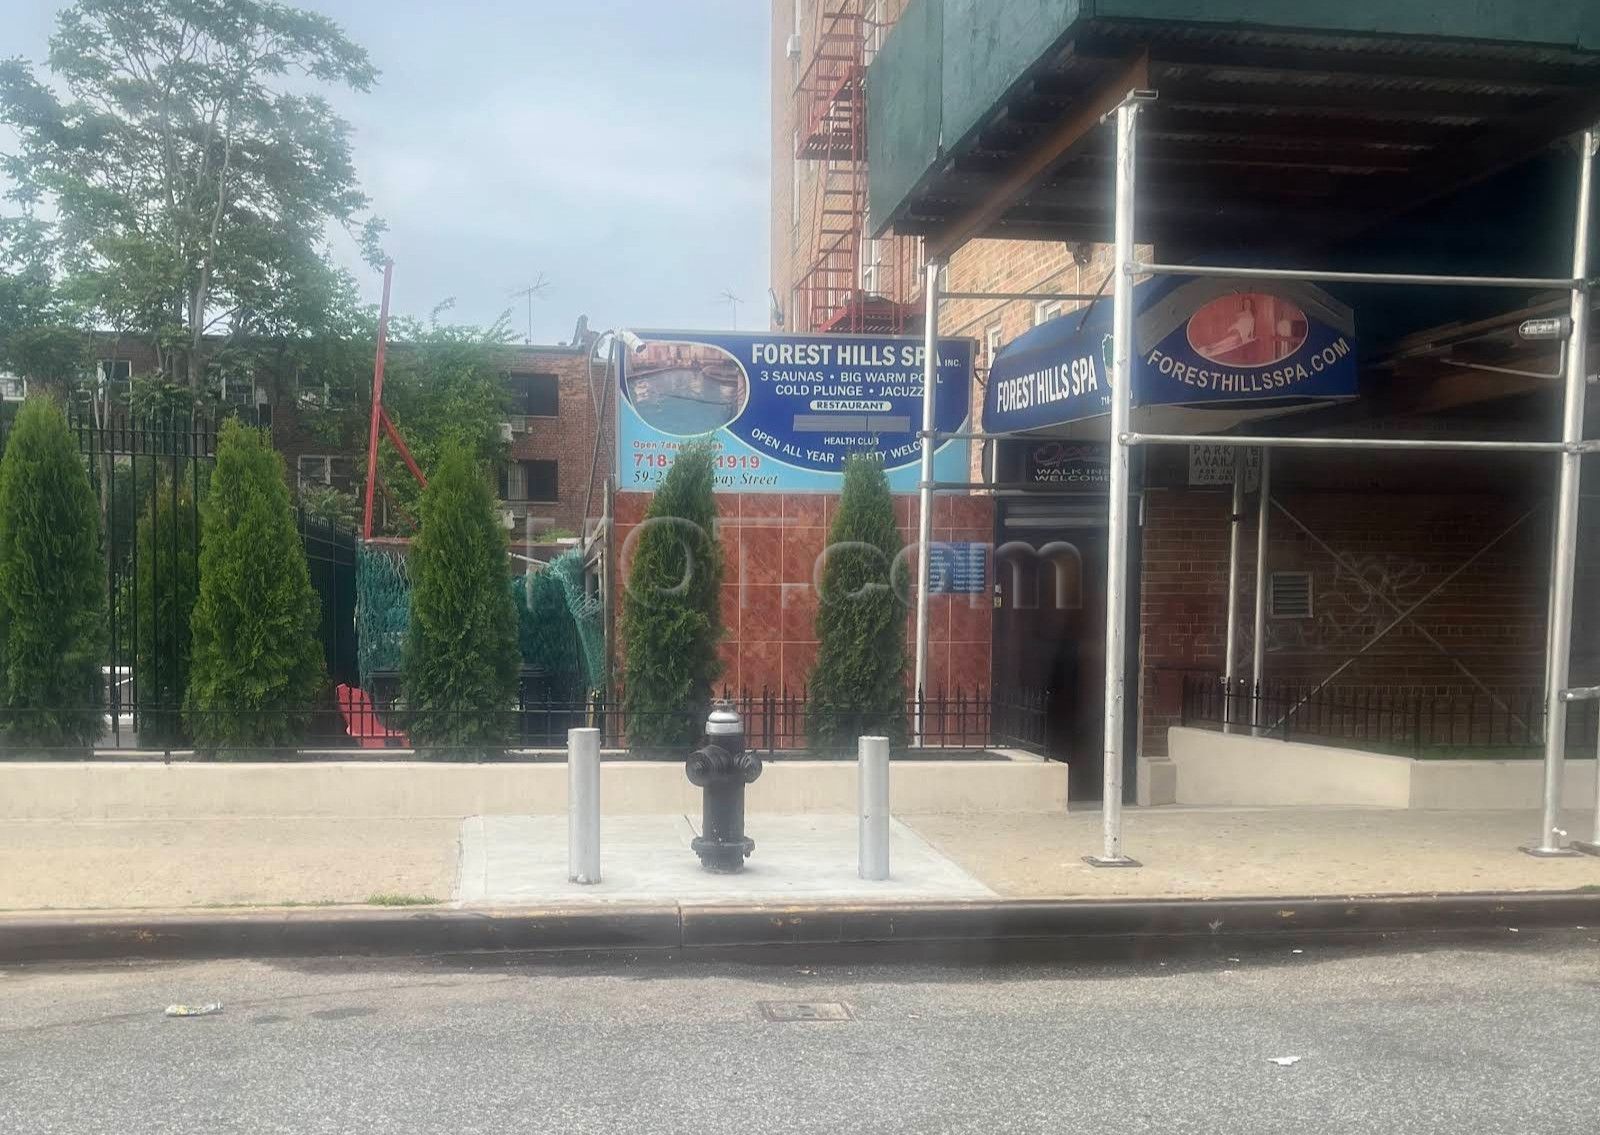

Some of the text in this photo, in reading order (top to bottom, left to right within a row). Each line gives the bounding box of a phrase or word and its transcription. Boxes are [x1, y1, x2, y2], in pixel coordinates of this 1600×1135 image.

[752, 343, 834, 366] FOREST
[837, 345, 896, 367] HILLS
[1147, 337, 1350, 392] FORESTHILLSSPA.COM
[760, 371, 944, 384] 3 SAUNAS BIG WARM POL
[997, 373, 1035, 414] FOREST
[1037, 363, 1070, 405] HILLS
[1071, 355, 1098, 397] SPA
[775, 385, 924, 398] COLD PLUNGE JACUZZ
[816, 401, 884, 411] RESTAURANT
[633, 441, 657, 450] Open
[751, 427, 780, 450] OPEN
[782, 445, 802, 458] ALL
[806, 449, 834, 463] YEAR
[824, 436, 880, 446] HEALTH CLUB
[740, 472, 779, 485] Street
